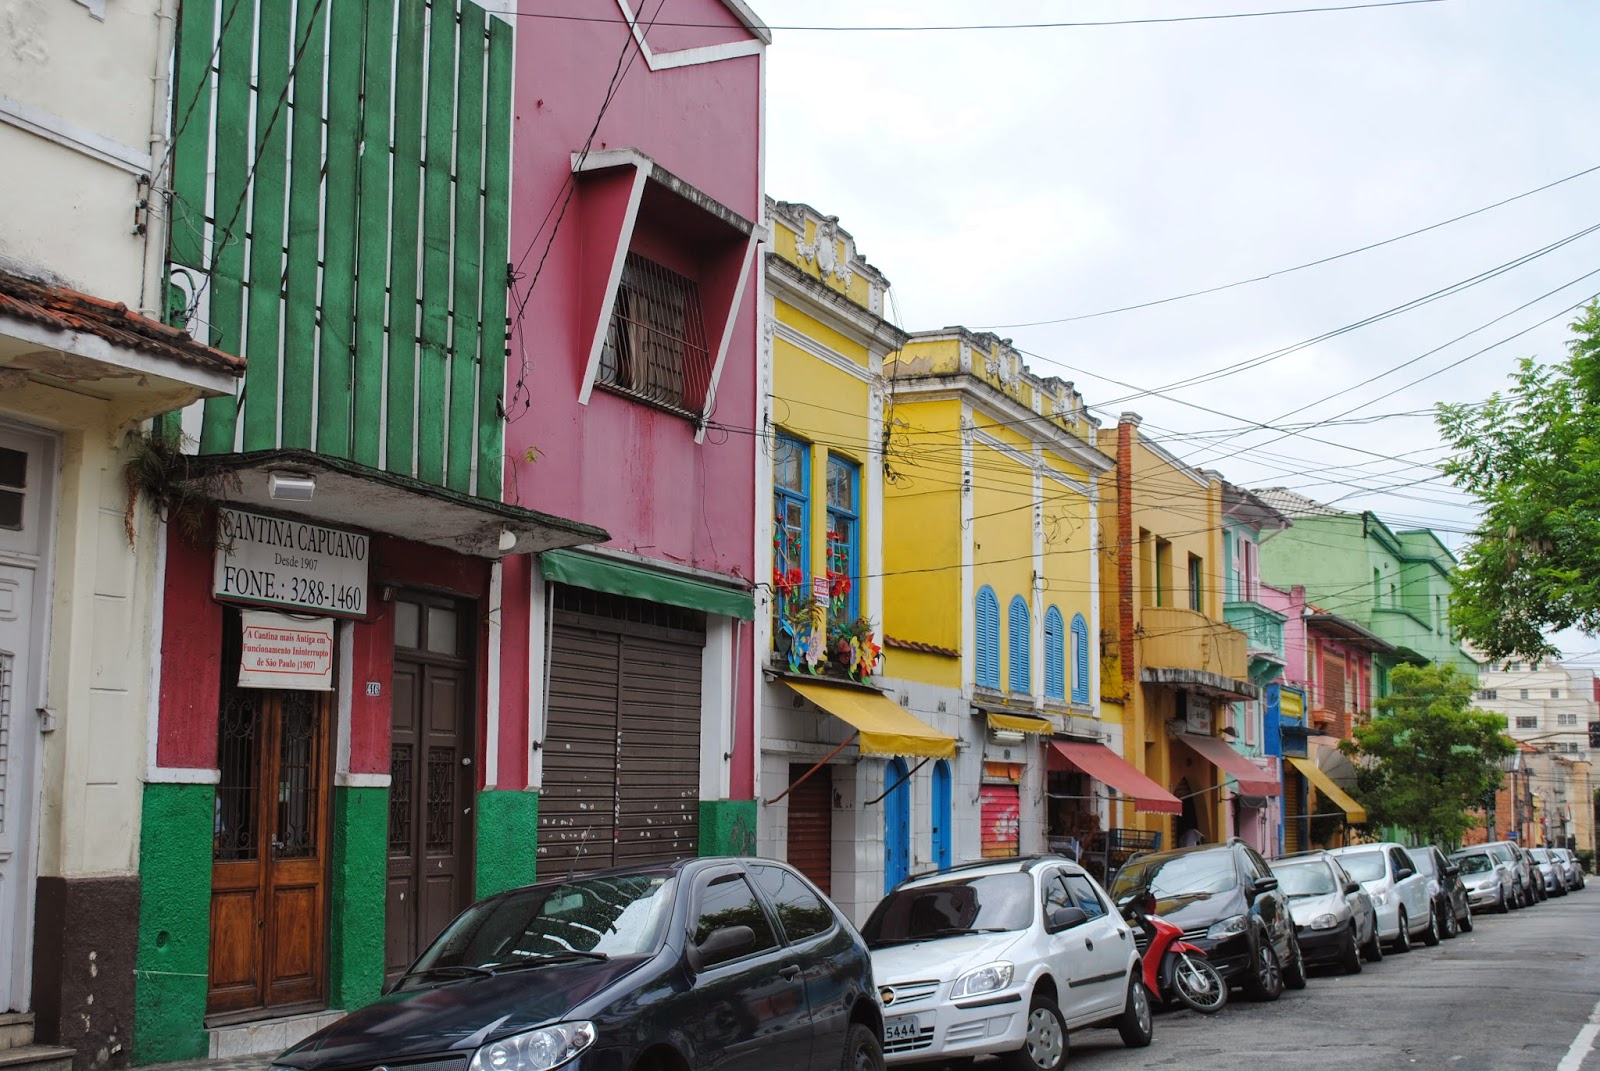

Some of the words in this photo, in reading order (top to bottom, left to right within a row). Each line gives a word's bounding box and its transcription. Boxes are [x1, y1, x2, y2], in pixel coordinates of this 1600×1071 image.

[225, 510, 294, 549] CANTINA
[298, 525, 366, 561] CAPUANO
[275, 552, 298, 568] Desde
[300, 557, 318, 571] 1907
[224, 565, 284, 600] FONE.:
[291, 577, 361, 611] 3288-1460
[254, 630, 278, 641] Cantina
[280, 633, 294, 642] mais
[296, 634, 315, 645] Antiga
[243, 643, 291, 655] Funcionamento
[293, 646, 329, 659] Ininterrupto
[257, 658, 264, 667] de
[265, 658, 277, 667] São
[279, 659, 296, 668] Paulo
[886, 1023, 915, 1039] 5444
